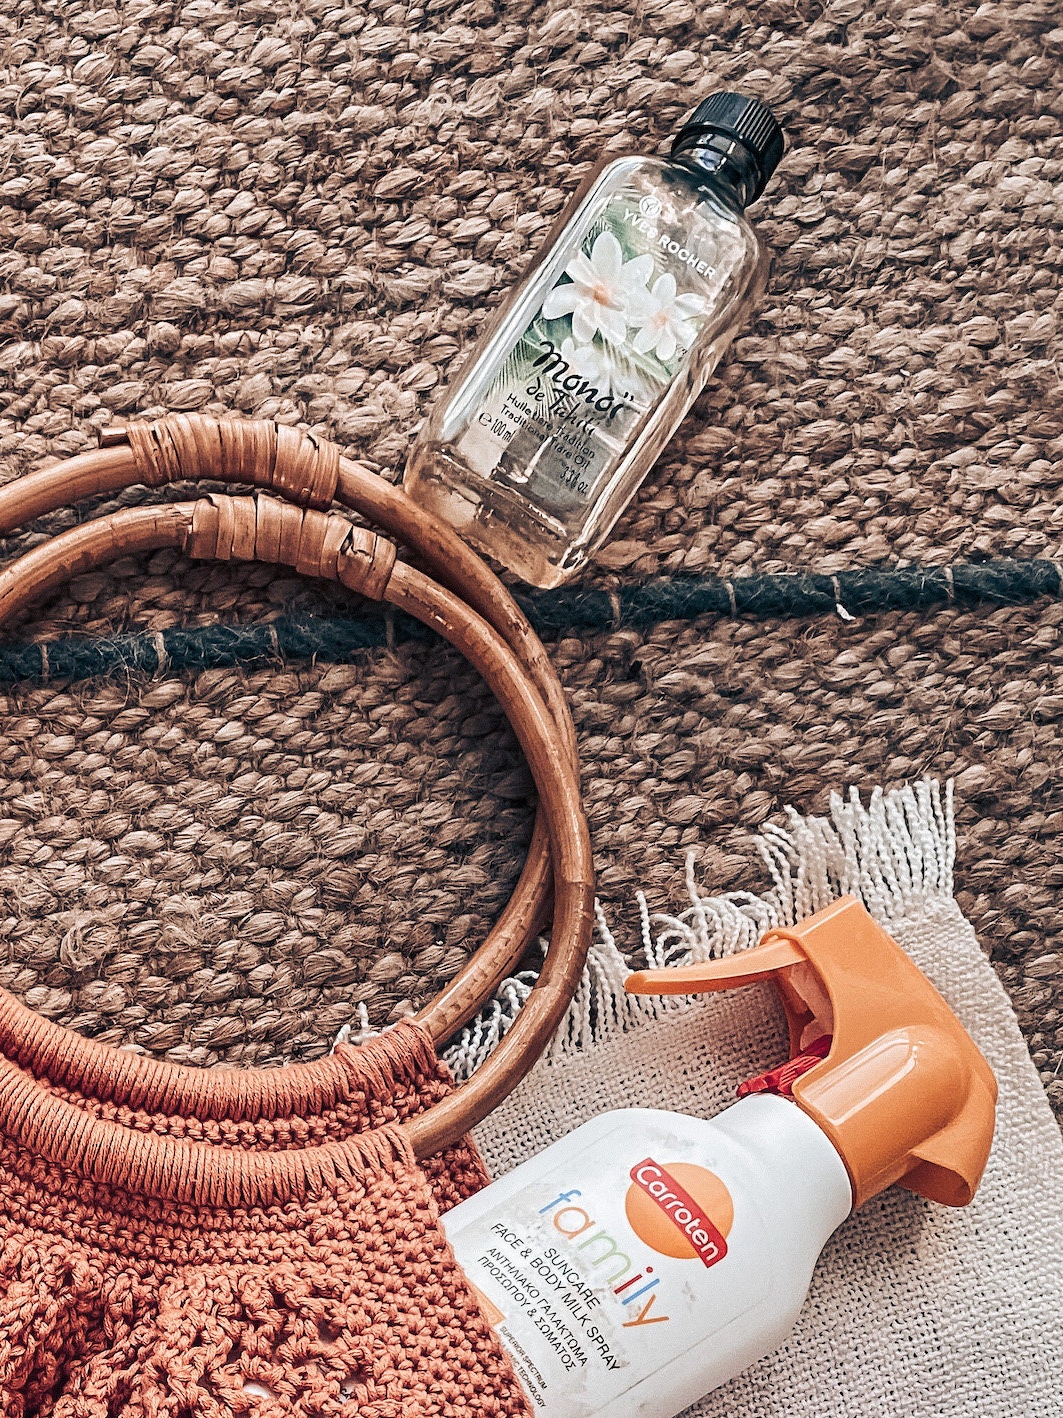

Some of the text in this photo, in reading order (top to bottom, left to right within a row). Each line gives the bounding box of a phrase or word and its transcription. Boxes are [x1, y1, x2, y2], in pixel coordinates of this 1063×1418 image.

[623, 208, 716, 280] YVES ROCHER
[506, 393, 532, 416] Huile
[526, 376, 545, 402] de
[490, 418, 506, 437] 100
[500, 404, 549, 443] Traditional
[574, 454, 591, 470] Oil
[636, 1164, 720, 1262] Carroten
[538, 1189, 670, 1328] family
[543, 1247, 601, 1310] SUNCARE
[477, 1256, 531, 1308] ΠΡΟΣΩΠΟΥ
[526, 1308, 537, 1318] &
[534, 1317, 577, 1373] ΣΩΜΑΤΟΣ
[486, 1247, 589, 1367] ΑΝΤΗΛΙΑΚΟ ΓΑΛΑΚΤΩΜΑ
[490, 1222, 621, 1372] FACE & BODY MILK SPRAY
[499, 1325, 525, 1357] SUPERIOR
[522, 1355, 548, 1391] SPECTRUM
[518, 1366, 547, 1408] TECHNOLOGY
